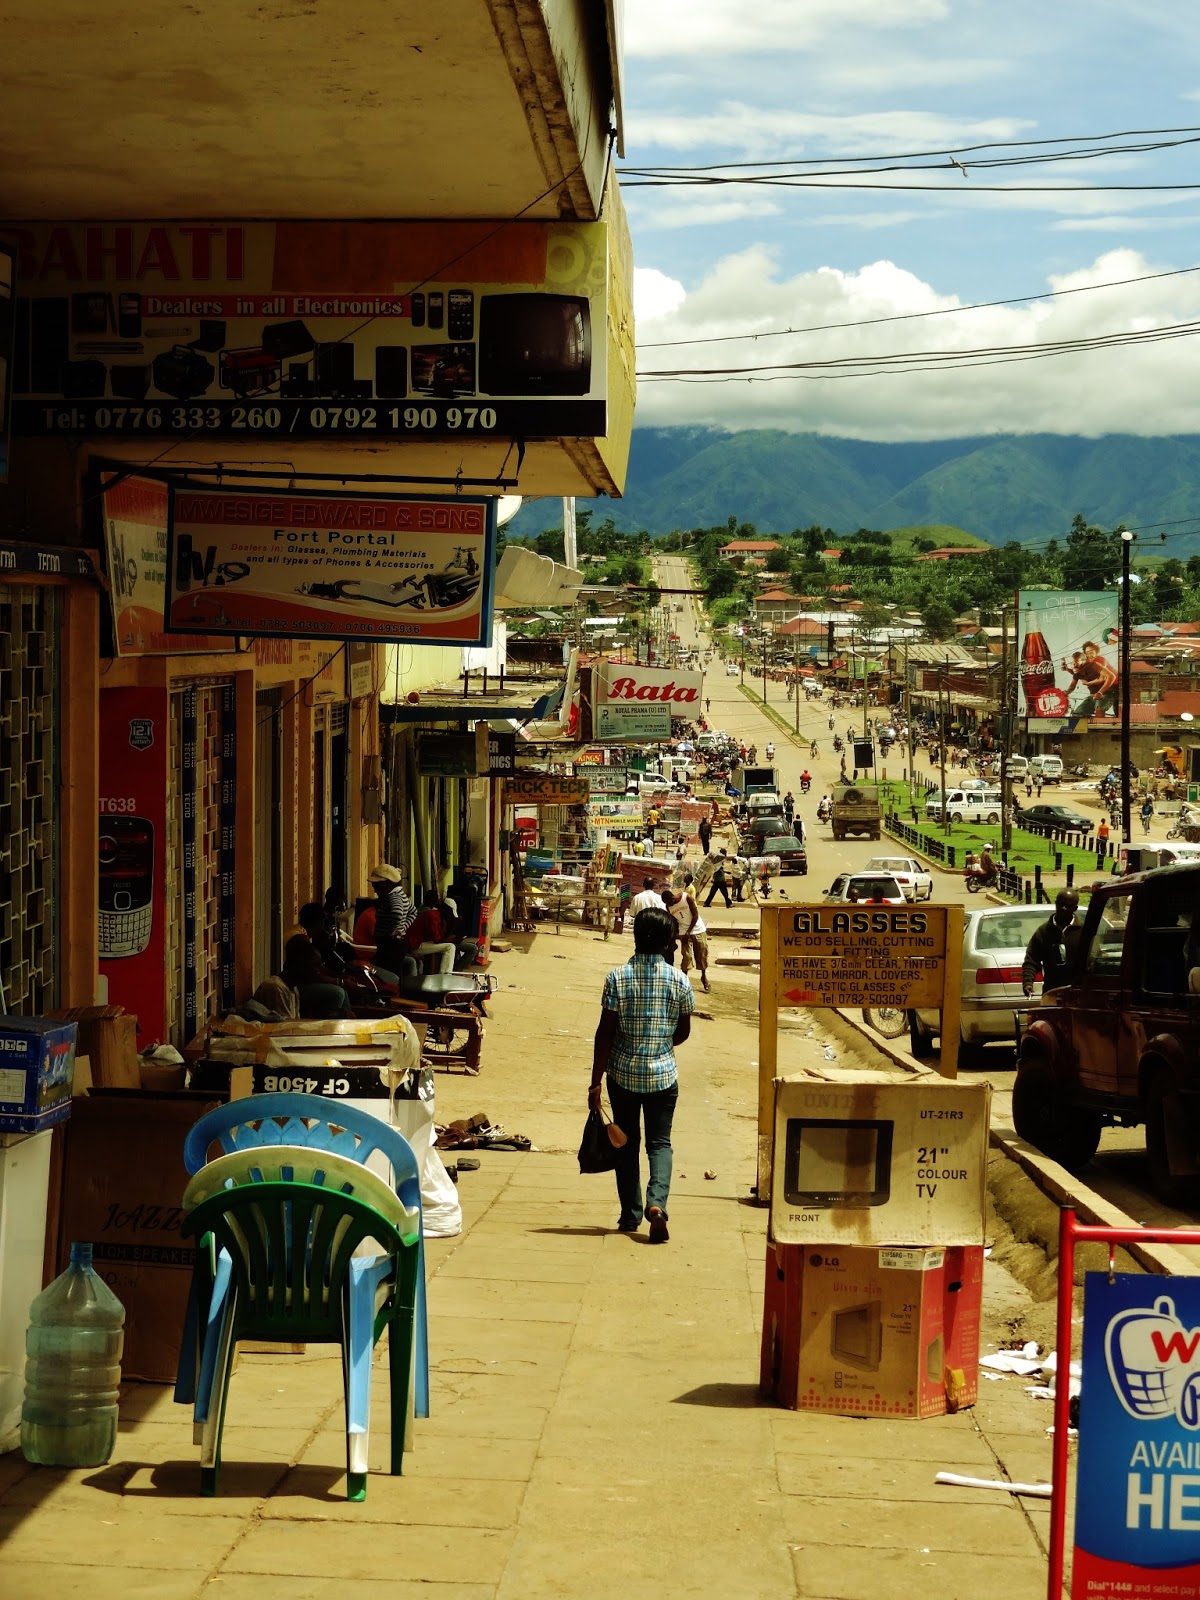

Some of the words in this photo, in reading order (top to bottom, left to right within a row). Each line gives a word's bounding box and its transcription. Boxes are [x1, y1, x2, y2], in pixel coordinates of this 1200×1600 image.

[148, 298, 223, 315] Dealers
[236, 298, 257, 315] in
[262, 299, 289, 315] all
[293, 297, 403, 316] Electronics
[41, 407, 85, 430] Tel:
[95, 407, 162, 429] 0776
[171, 407, 222, 429] 333
[230, 407, 282, 429] 260
[288, 407, 300, 432] /
[309, 407, 378, 429] 0792
[388, 407, 438, 429] 190
[446, 407, 497, 429] 970
[179, 499, 286, 523] MWESIGE
[290, 503, 388, 527] EDWARD
[394, 507, 413, 528] &
[418, 507, 481, 530] SONS
[273, 529, 319, 542] Fort
[328, 531, 396, 546] Portal
[231, 543, 268, 552] Dealers
[287, 545, 329, 556] Glasses,
[332, 547, 378, 558] Plumbing
[381, 548, 427, 559] Materials
[246, 555, 265, 563] and
[283, 556, 308, 566] types
[325, 558, 361, 567] Phones
[374, 560, 435, 570] Accessories
[1045, 597, 1081, 609] OPEN
[1042, 607, 1111, 622] HAPPINESS
[259, 619, 287, 628] 0782
[292, 621, 333, 630] 503097
[378, 624, 421, 634] 495936
[607, 677, 699, 703] Bata
[1038, 697, 1061, 712] UP
[98, 798, 137, 813] T638
[595, 817, 610, 825] MTN
[793, 912, 928, 934] GLASSES
[783, 937, 802, 946] WE
[806, 937, 822, 946] DO
[884, 937, 934, 947] CUTTING
[843, 948, 890, 956] FITTING
[783, 958, 799, 968] WE
[802, 958, 827, 969] HAVE
[904, 959, 938, 970] TINTED
[783, 969, 829, 980] FROSTED
[805, 982, 847, 991] PLASTIC
[850, 982, 896, 992] GLASSES
[900, 981, 913, 992] ETC
[838, 994, 909, 1005] 0782-503097
[263, 1075, 319, 1095] 450B
[322, 1077, 350, 1096] CF
[920, 1110, 964, 1120] UT-21R3
[917, 1147, 949, 1164] 21"
[917, 1169, 967, 1180] COLOUR
[915, 1184, 938, 1198] TV
[101, 1203, 184, 1233] JAZZ
[788, 1214, 820, 1222] FRONT
[824, 1257, 840, 1266] LG
[833, 1282, 858, 1293] Ultra
[1126, 1472, 1200, 1531] HE
[1134, 1583, 1151, 1592] and
[1153, 1584, 1179, 1594] select
[1180, 1587, 1196, 1596] pay
